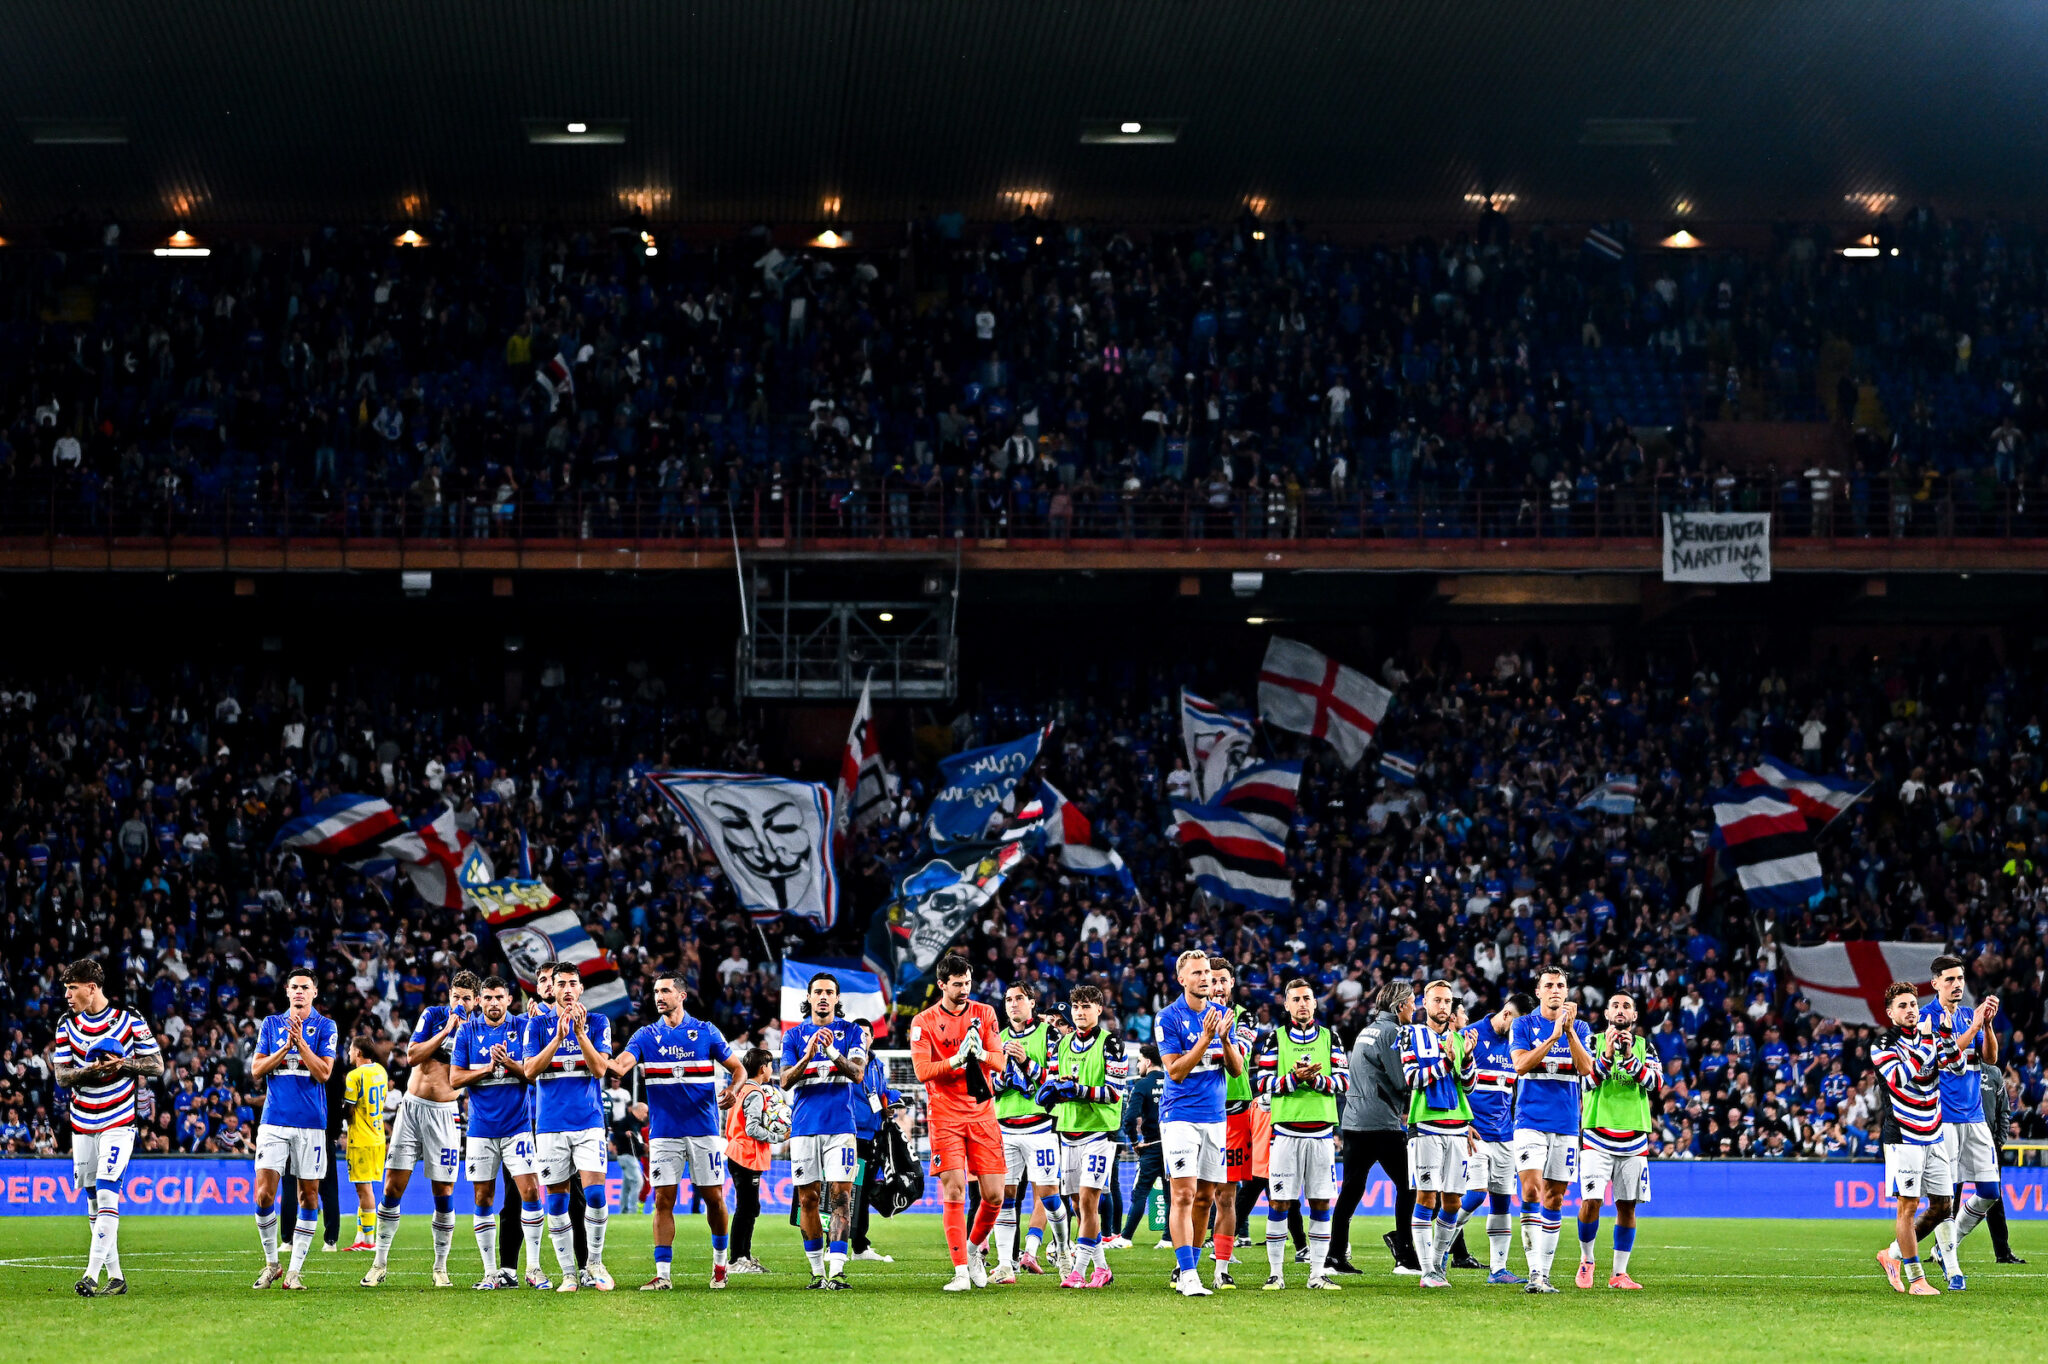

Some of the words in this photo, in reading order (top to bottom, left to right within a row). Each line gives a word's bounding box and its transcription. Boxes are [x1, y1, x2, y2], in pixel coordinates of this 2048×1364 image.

[1670, 513, 1764, 546] BENVENUTA
[1672, 543, 1762, 573] MARTINA
[675, 1050, 695, 1060] sport
[1550, 1045, 1570, 1054] sport
[106, 1146, 120, 1165] 3
[312, 1146, 321, 1164] 7
[440, 1148, 458, 1167] 28
[515, 1140, 535, 1158] 44
[841, 1147, 855, 1167] 18
[1036, 1148, 1055, 1167] 80
[708, 1151, 722, 1171] 14
[1088, 1154, 1107, 1174] 33
[1155, 1194, 1166, 1224] Serie
